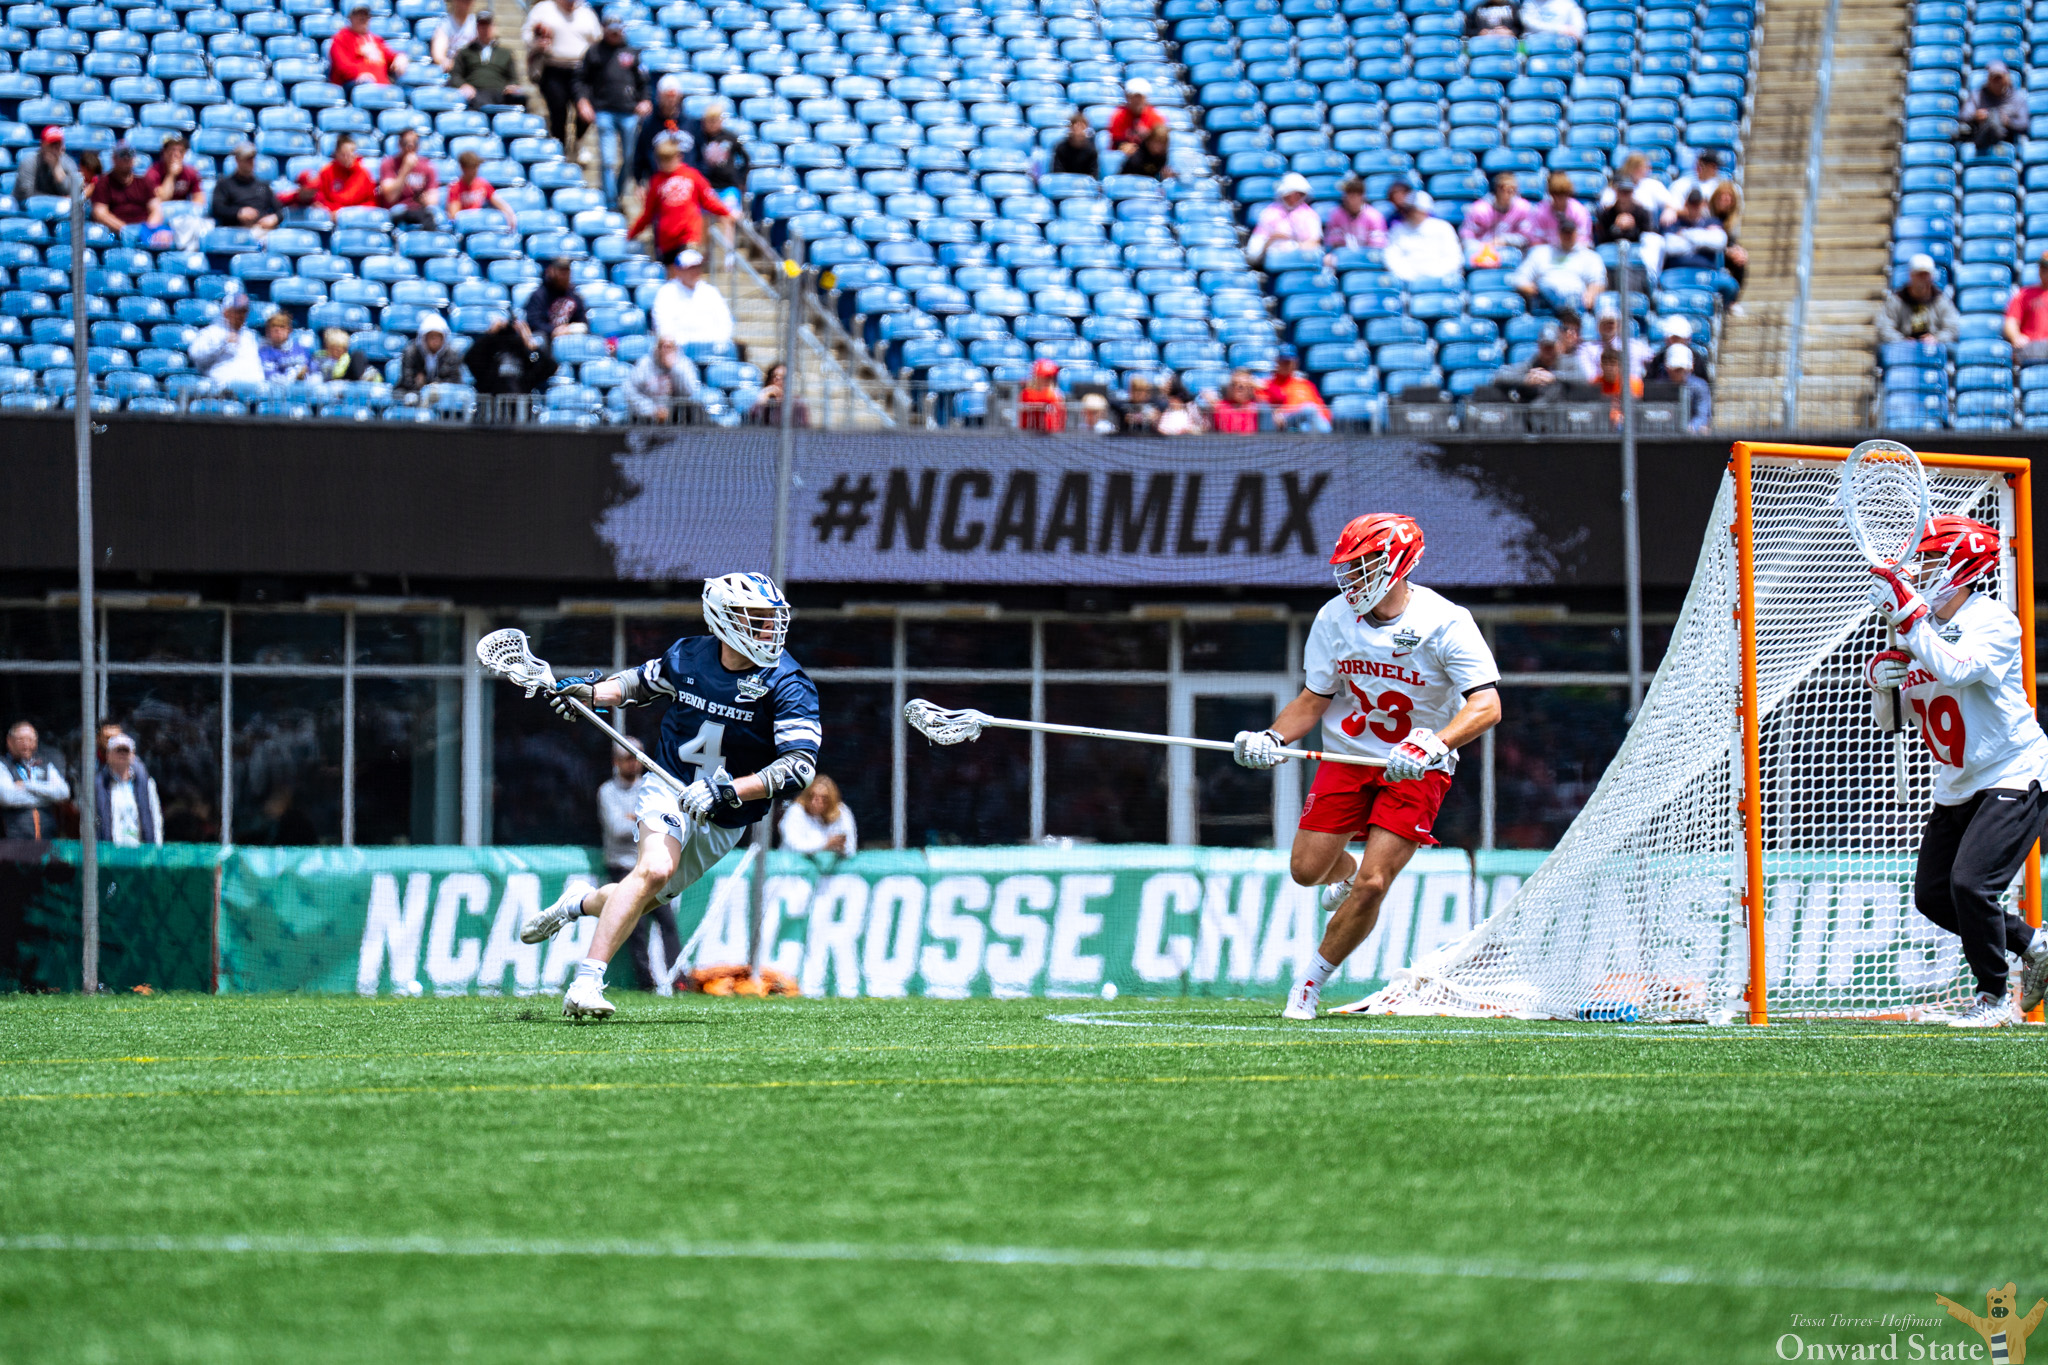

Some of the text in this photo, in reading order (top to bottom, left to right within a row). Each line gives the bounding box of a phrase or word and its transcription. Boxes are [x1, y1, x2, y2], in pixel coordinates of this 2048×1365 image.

[813, 468, 1330, 554] #NCAAMLAX
[1395, 523, 1414, 545] C
[1968, 532, 1986, 554] C
[678, 690, 755, 722] PENN STATE
[1911, 694, 1967, 769] 19
[678, 719, 727, 783] 4
[648, 870, 1115, 991] ACROSSE
